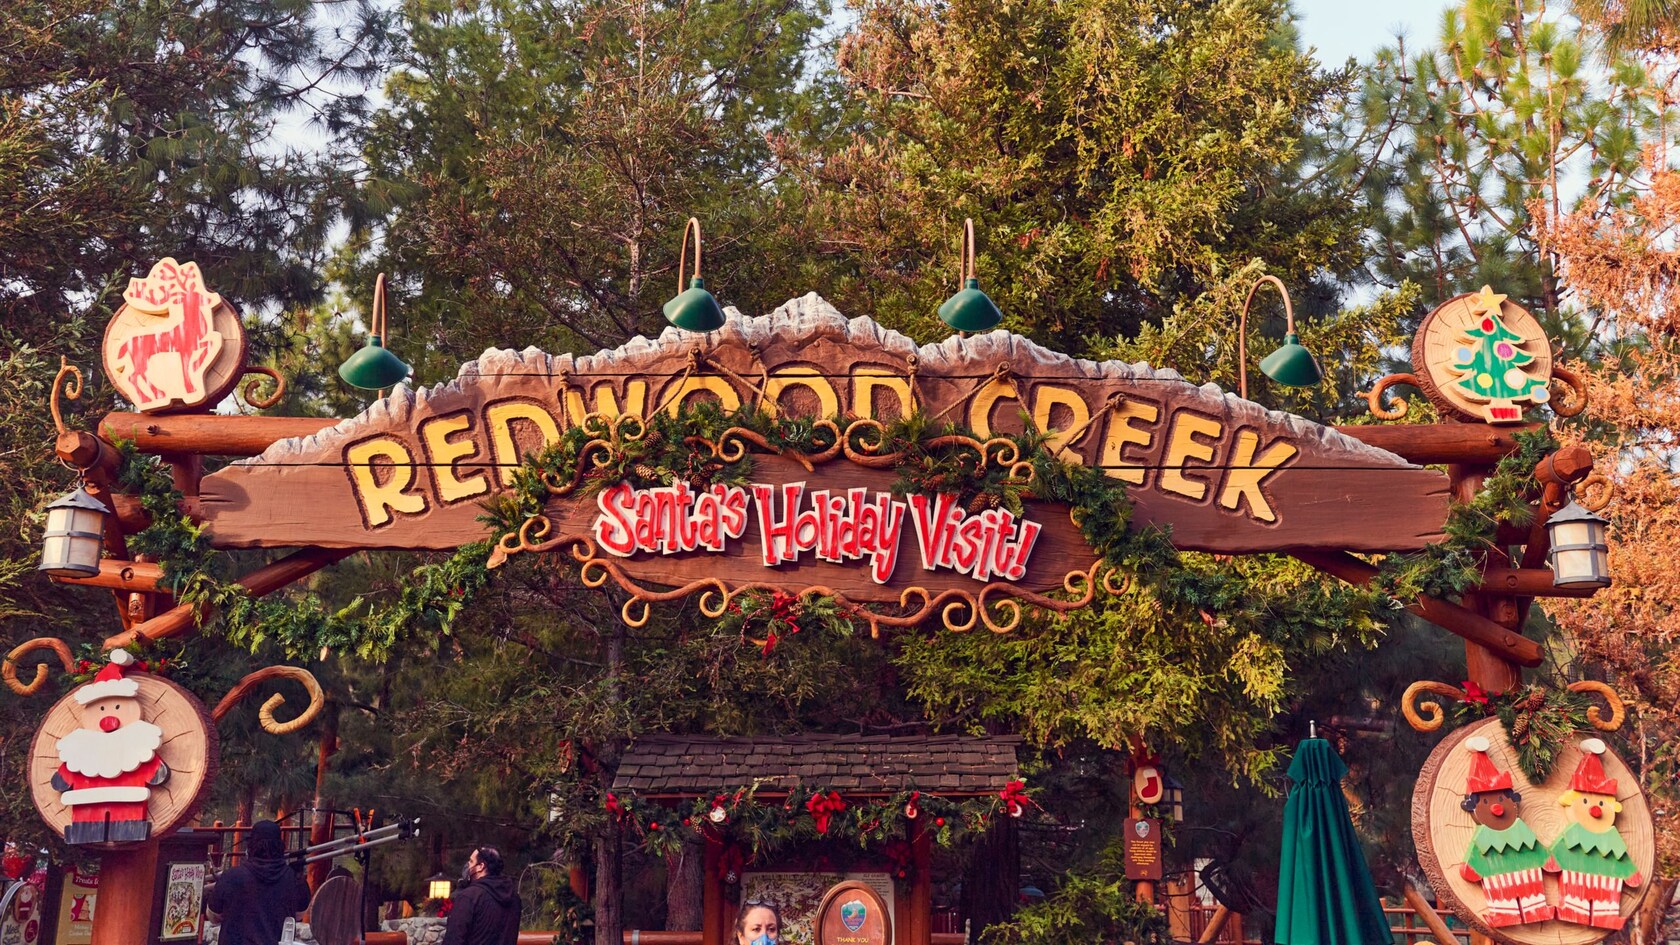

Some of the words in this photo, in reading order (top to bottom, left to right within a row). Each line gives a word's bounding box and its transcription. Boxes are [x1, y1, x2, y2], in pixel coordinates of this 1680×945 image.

[969, 378, 1298, 523] CREEK
[597, 481, 748, 556] Santa's
[752, 482, 905, 583] Holiday
[907, 491, 1041, 581] Visit!
